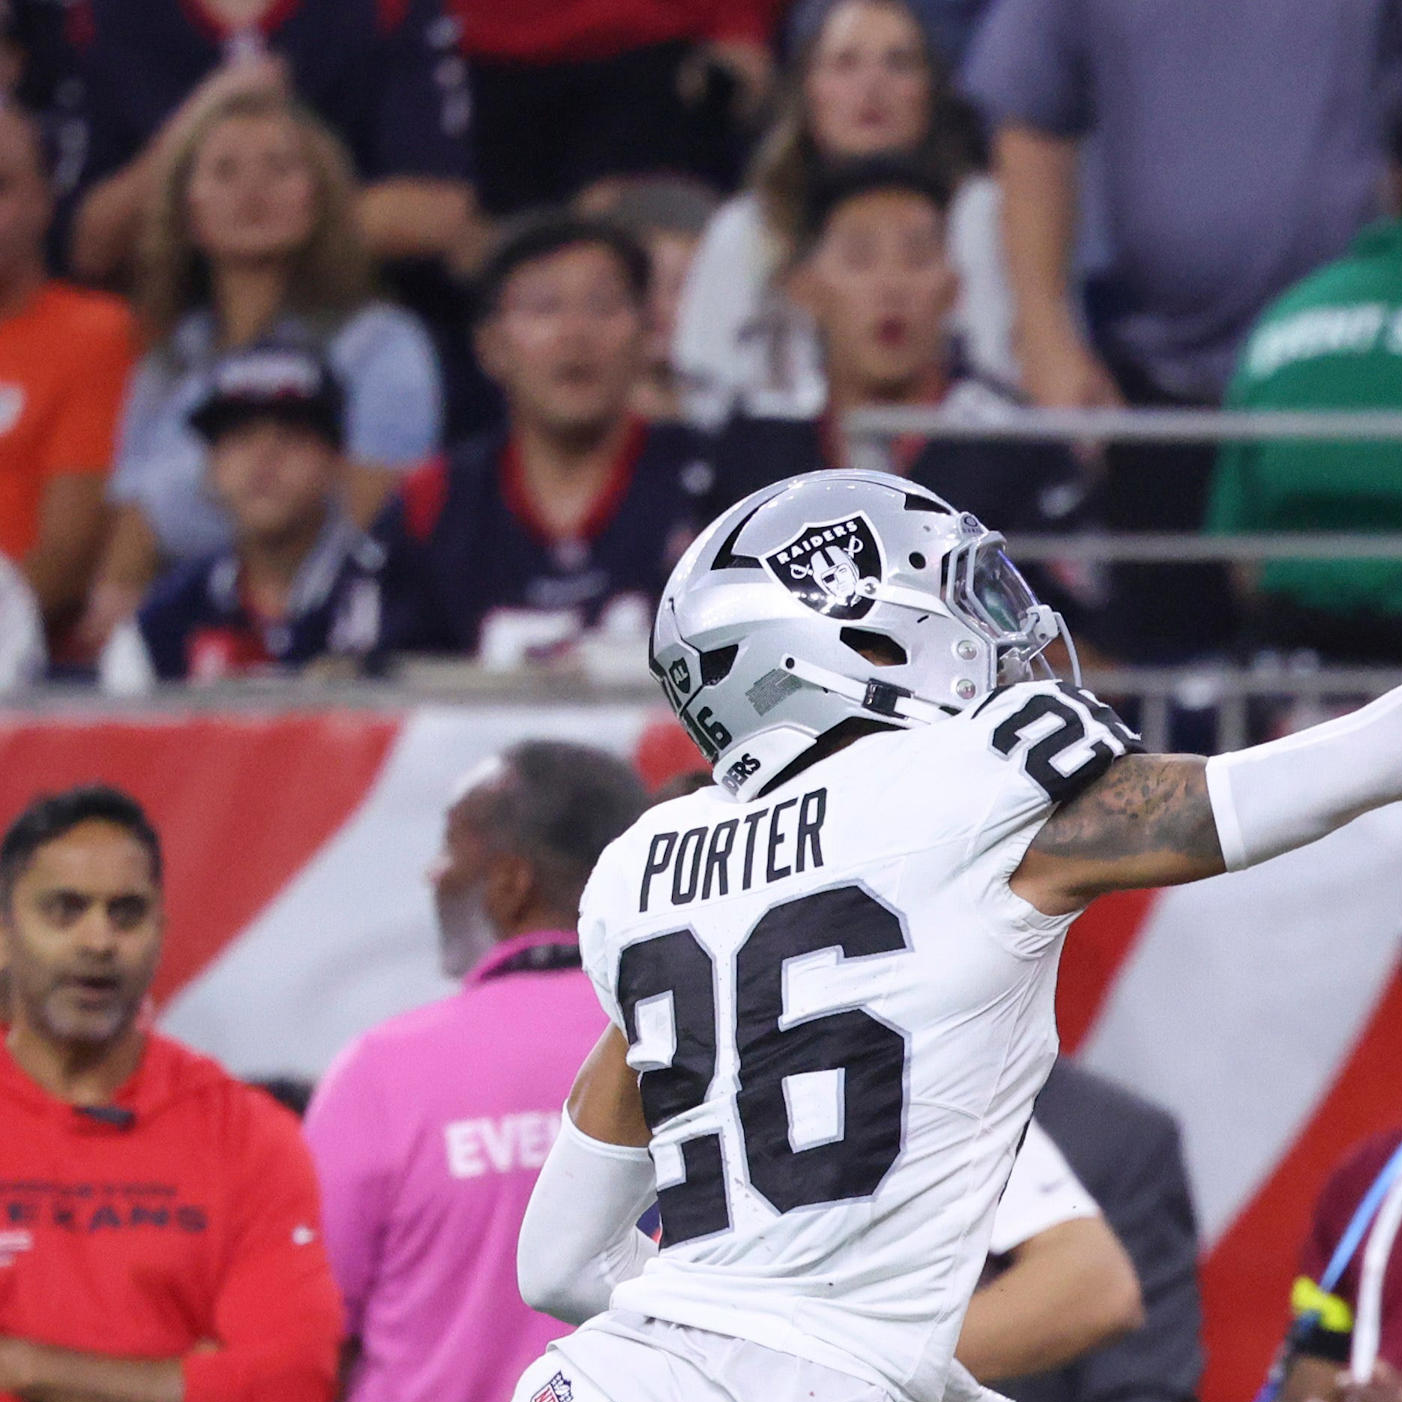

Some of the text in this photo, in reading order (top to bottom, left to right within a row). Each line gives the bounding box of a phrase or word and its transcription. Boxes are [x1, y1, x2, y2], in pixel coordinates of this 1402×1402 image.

[776, 521, 858, 565] RAIDERS
[638, 787, 828, 913] PORTER
[614, 880, 912, 1250] 26
